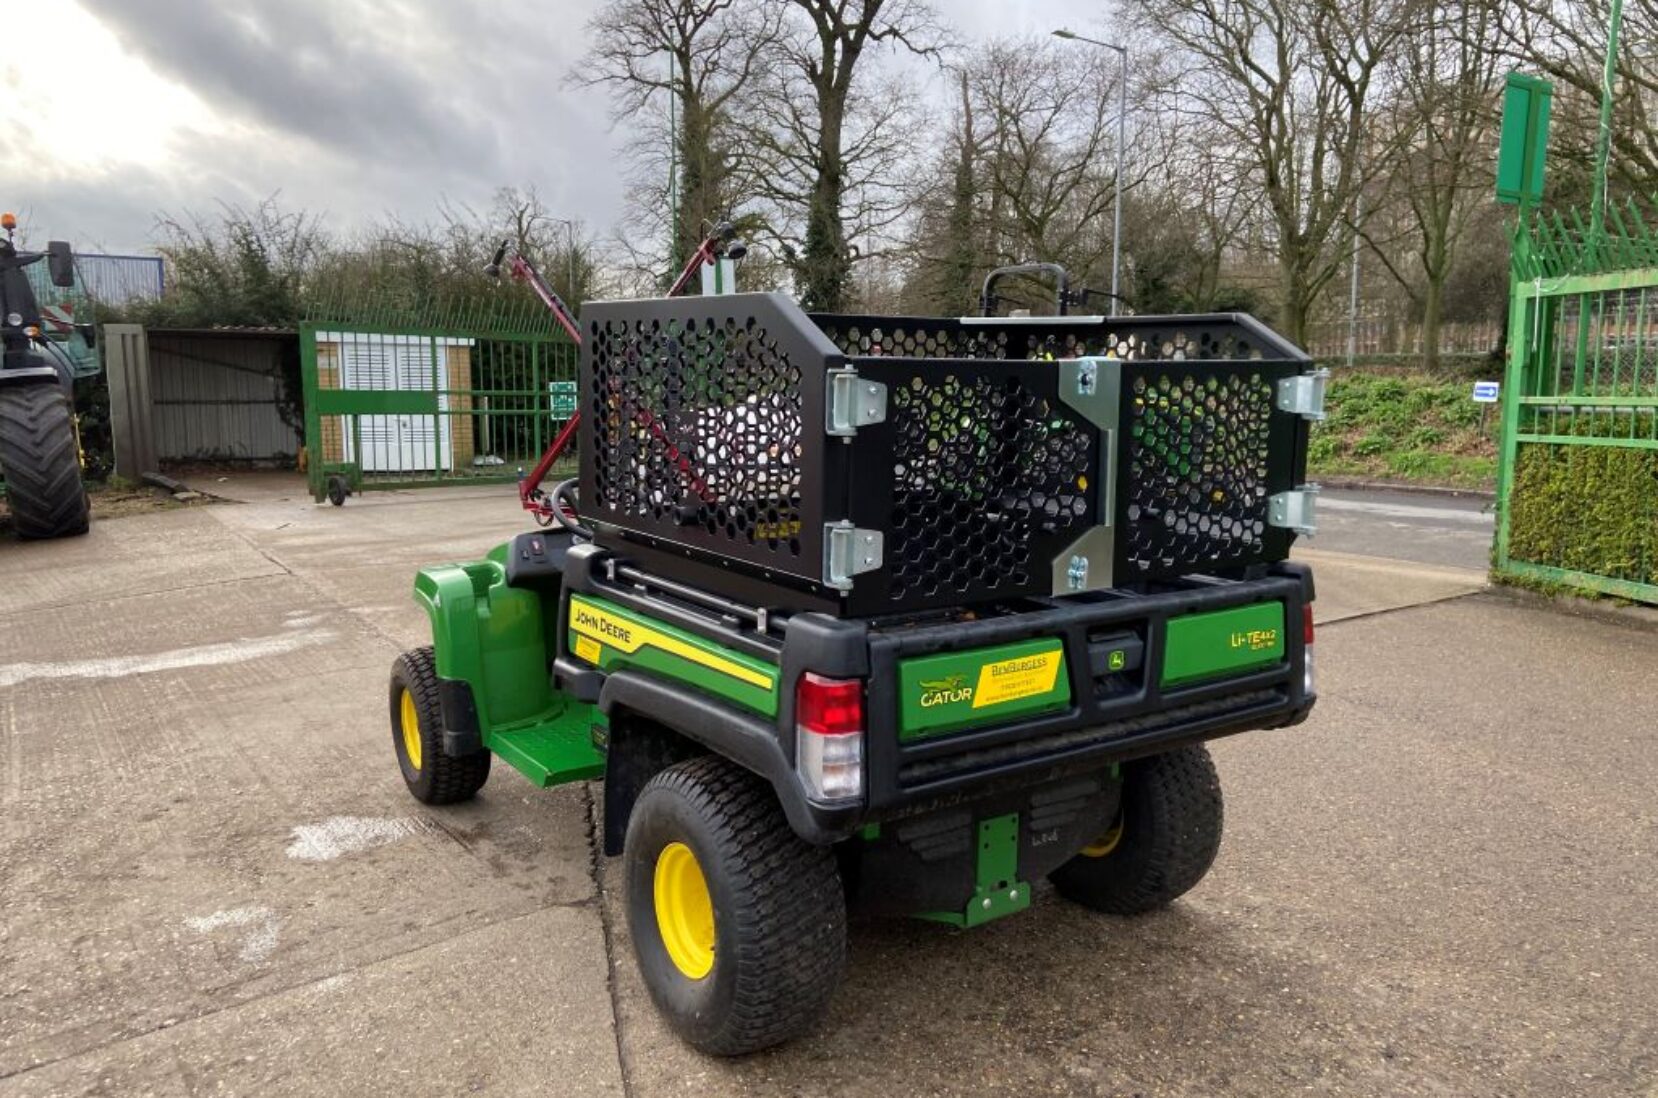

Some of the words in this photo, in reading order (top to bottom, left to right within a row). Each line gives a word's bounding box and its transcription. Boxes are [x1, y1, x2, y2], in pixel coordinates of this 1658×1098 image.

[575, 609, 598, 630] JOHN
[600, 617, 631, 644] DEERE
[920, 687, 973, 708] GATOR
